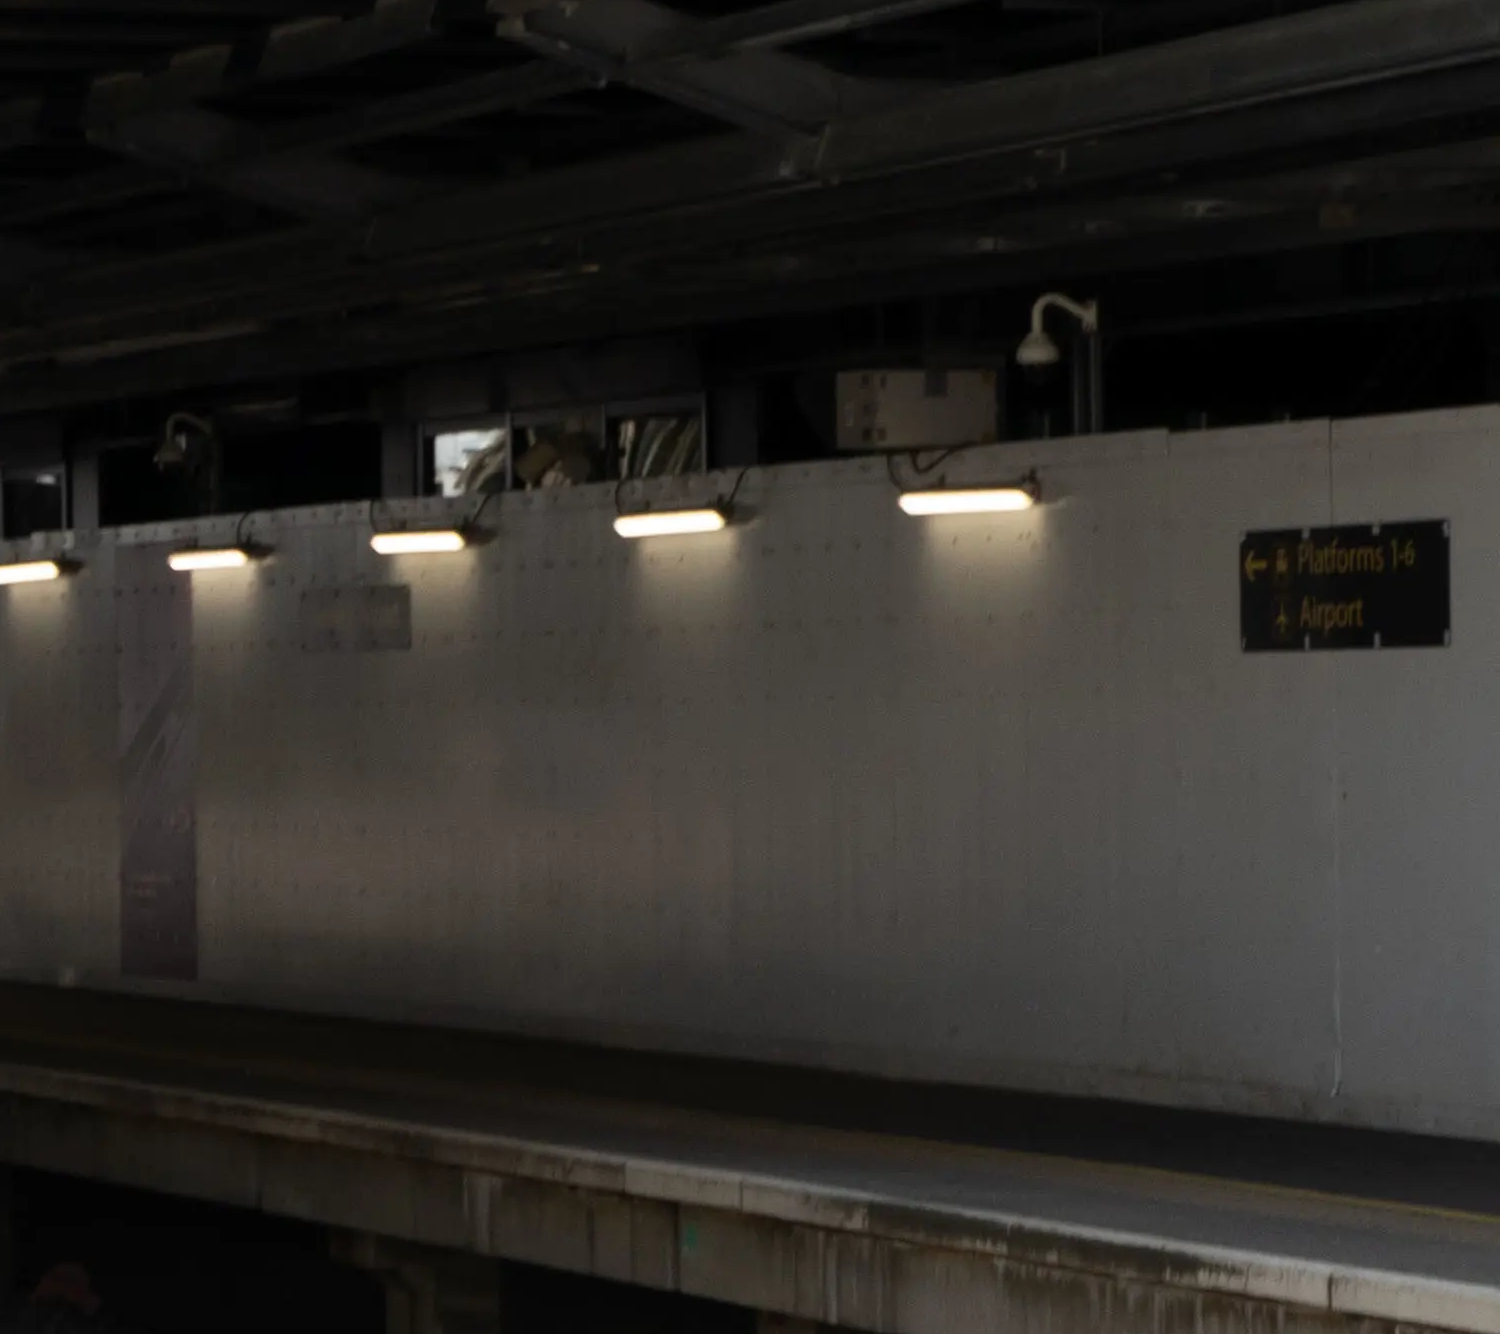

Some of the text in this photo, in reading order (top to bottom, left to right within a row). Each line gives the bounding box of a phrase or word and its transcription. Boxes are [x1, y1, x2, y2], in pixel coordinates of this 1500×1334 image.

[1298, 537, 1416, 575] Platforms 1-6
[1300, 594, 1364, 637] Airport
